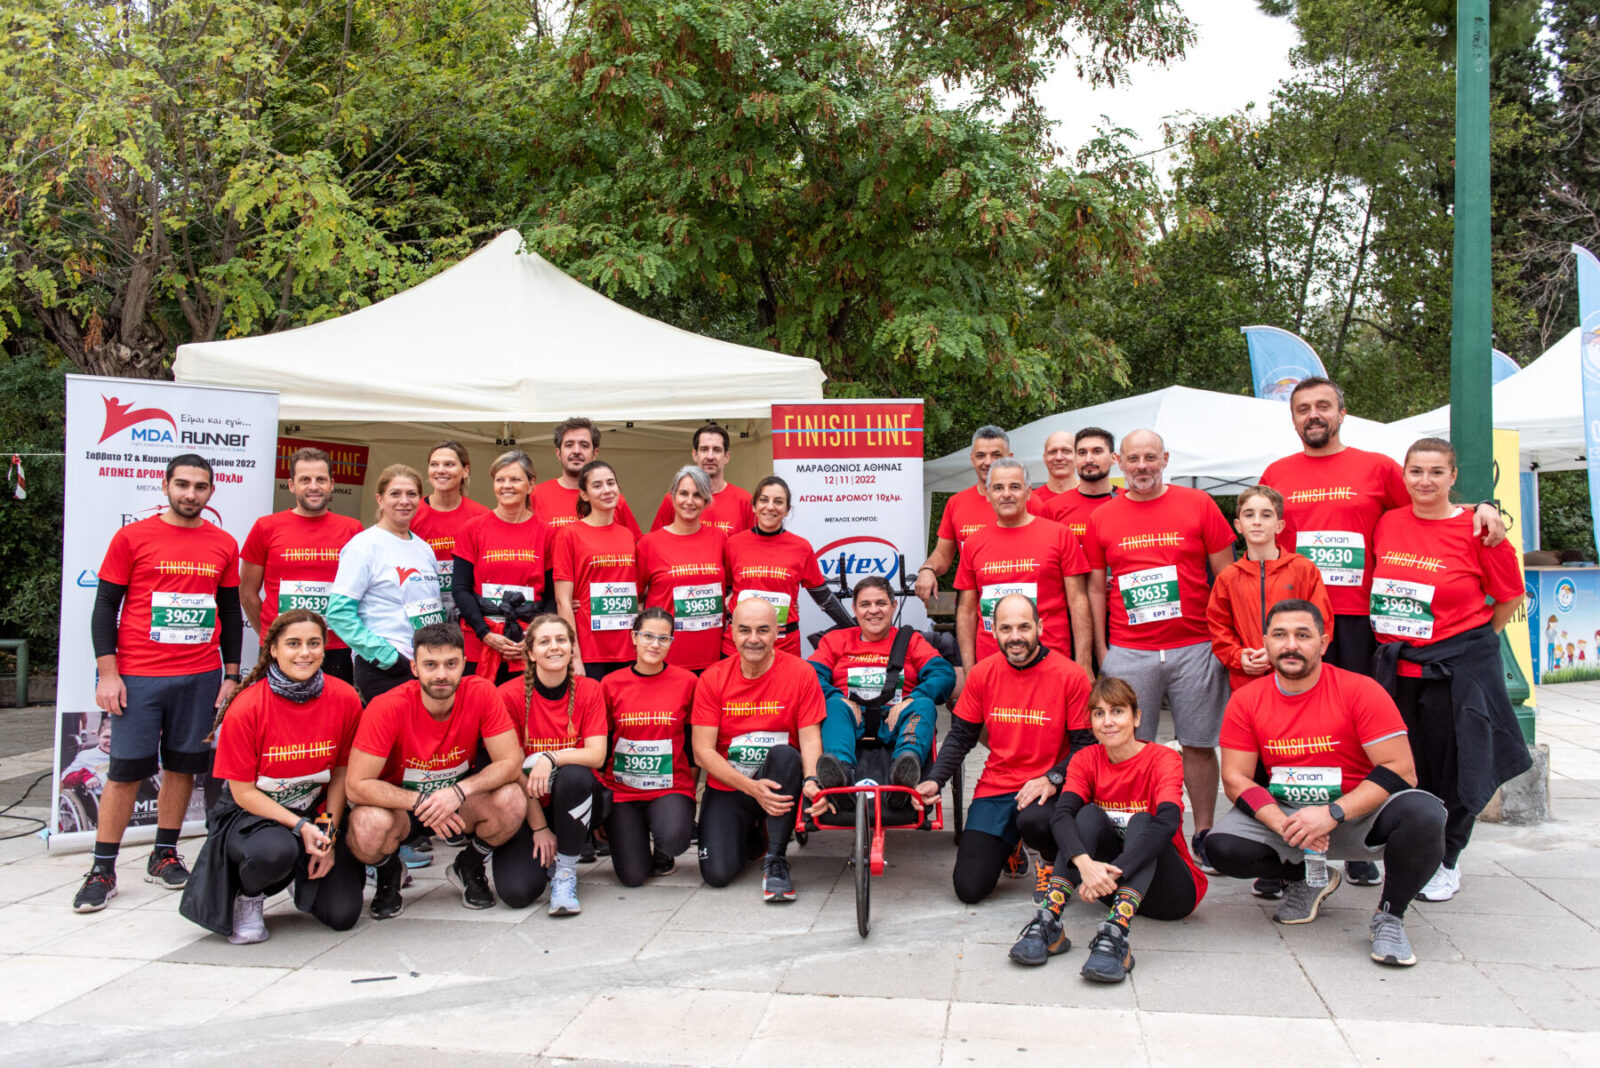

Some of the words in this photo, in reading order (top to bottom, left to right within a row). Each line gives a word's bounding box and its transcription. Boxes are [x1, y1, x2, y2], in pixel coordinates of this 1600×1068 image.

[131, 428, 173, 443] MDA
[785, 415, 856, 447] FINISH
[866, 414, 912, 446] LINE
[86, 451, 121, 461] Σάββατο
[124, 453, 133, 462] 12
[142, 454, 174, 463] Κυριακ
[236, 460, 256, 468] 2022
[99, 467, 134, 478] ΑΓΩΝΕΣ
[136, 469, 166, 479] ΔΡΟΜ
[796, 464, 861, 472] ΜΑΡΑΘΩΝΙΟΣ
[863, 463, 902, 471] ΑΘΗΝΑΣ
[835, 494, 873, 502] ΔΡΟΜΟΥ
[1292, 488, 1325, 503] FINISH
[1329, 486, 1352, 500] LINE
[1122, 534, 1155, 550] FINISH
[1158, 532, 1179, 546] LINE
[285, 548, 317, 561] FINISH
[320, 548, 340, 561] LINE
[486, 549, 515, 563] FINISH
[518, 549, 535, 563] LINE
[593, 554, 616, 568] FINISH
[618, 553, 633, 567] LINE
[1309, 548, 1353, 563] 39630
[1383, 551, 1417, 568] FINISH
[1417, 555, 1444, 573] LINE
[160, 560, 193, 575] FINISH
[197, 562, 216, 578] LINE
[672, 562, 699, 577] FINISH
[701, 562, 719, 575] LINE
[820, 552, 887, 575] vitex
[984, 560, 1013, 575] FINISH
[1016, 559, 1035, 573] LINE
[743, 566, 768, 579] FINISH
[770, 567, 788, 580] LINE
[1130, 583, 1169, 603] 39635
[289, 596, 328, 610] 39639
[602, 598, 632, 611] 39549
[685, 599, 717, 613] 39638
[1381, 597, 1424, 615] 39636
[164, 609, 207, 624] 39627
[727, 702, 757, 716] FINISH
[760, 701, 780, 715] LINE
[621, 711, 651, 726] FINISH
[653, 711, 673, 726] LINE
[994, 707, 1023, 724] FINISH
[1024, 709, 1046, 726] LINE
[269, 744, 305, 763] FINISH
[309, 740, 332, 759] LINE
[1268, 738, 1305, 756] FINISH
[1308, 735, 1335, 754] LINE
[739, 747, 769, 761] 3963
[624, 756, 662, 770] 39637
[1283, 786, 1330, 802] 39590
[134, 800, 158, 812] MD
